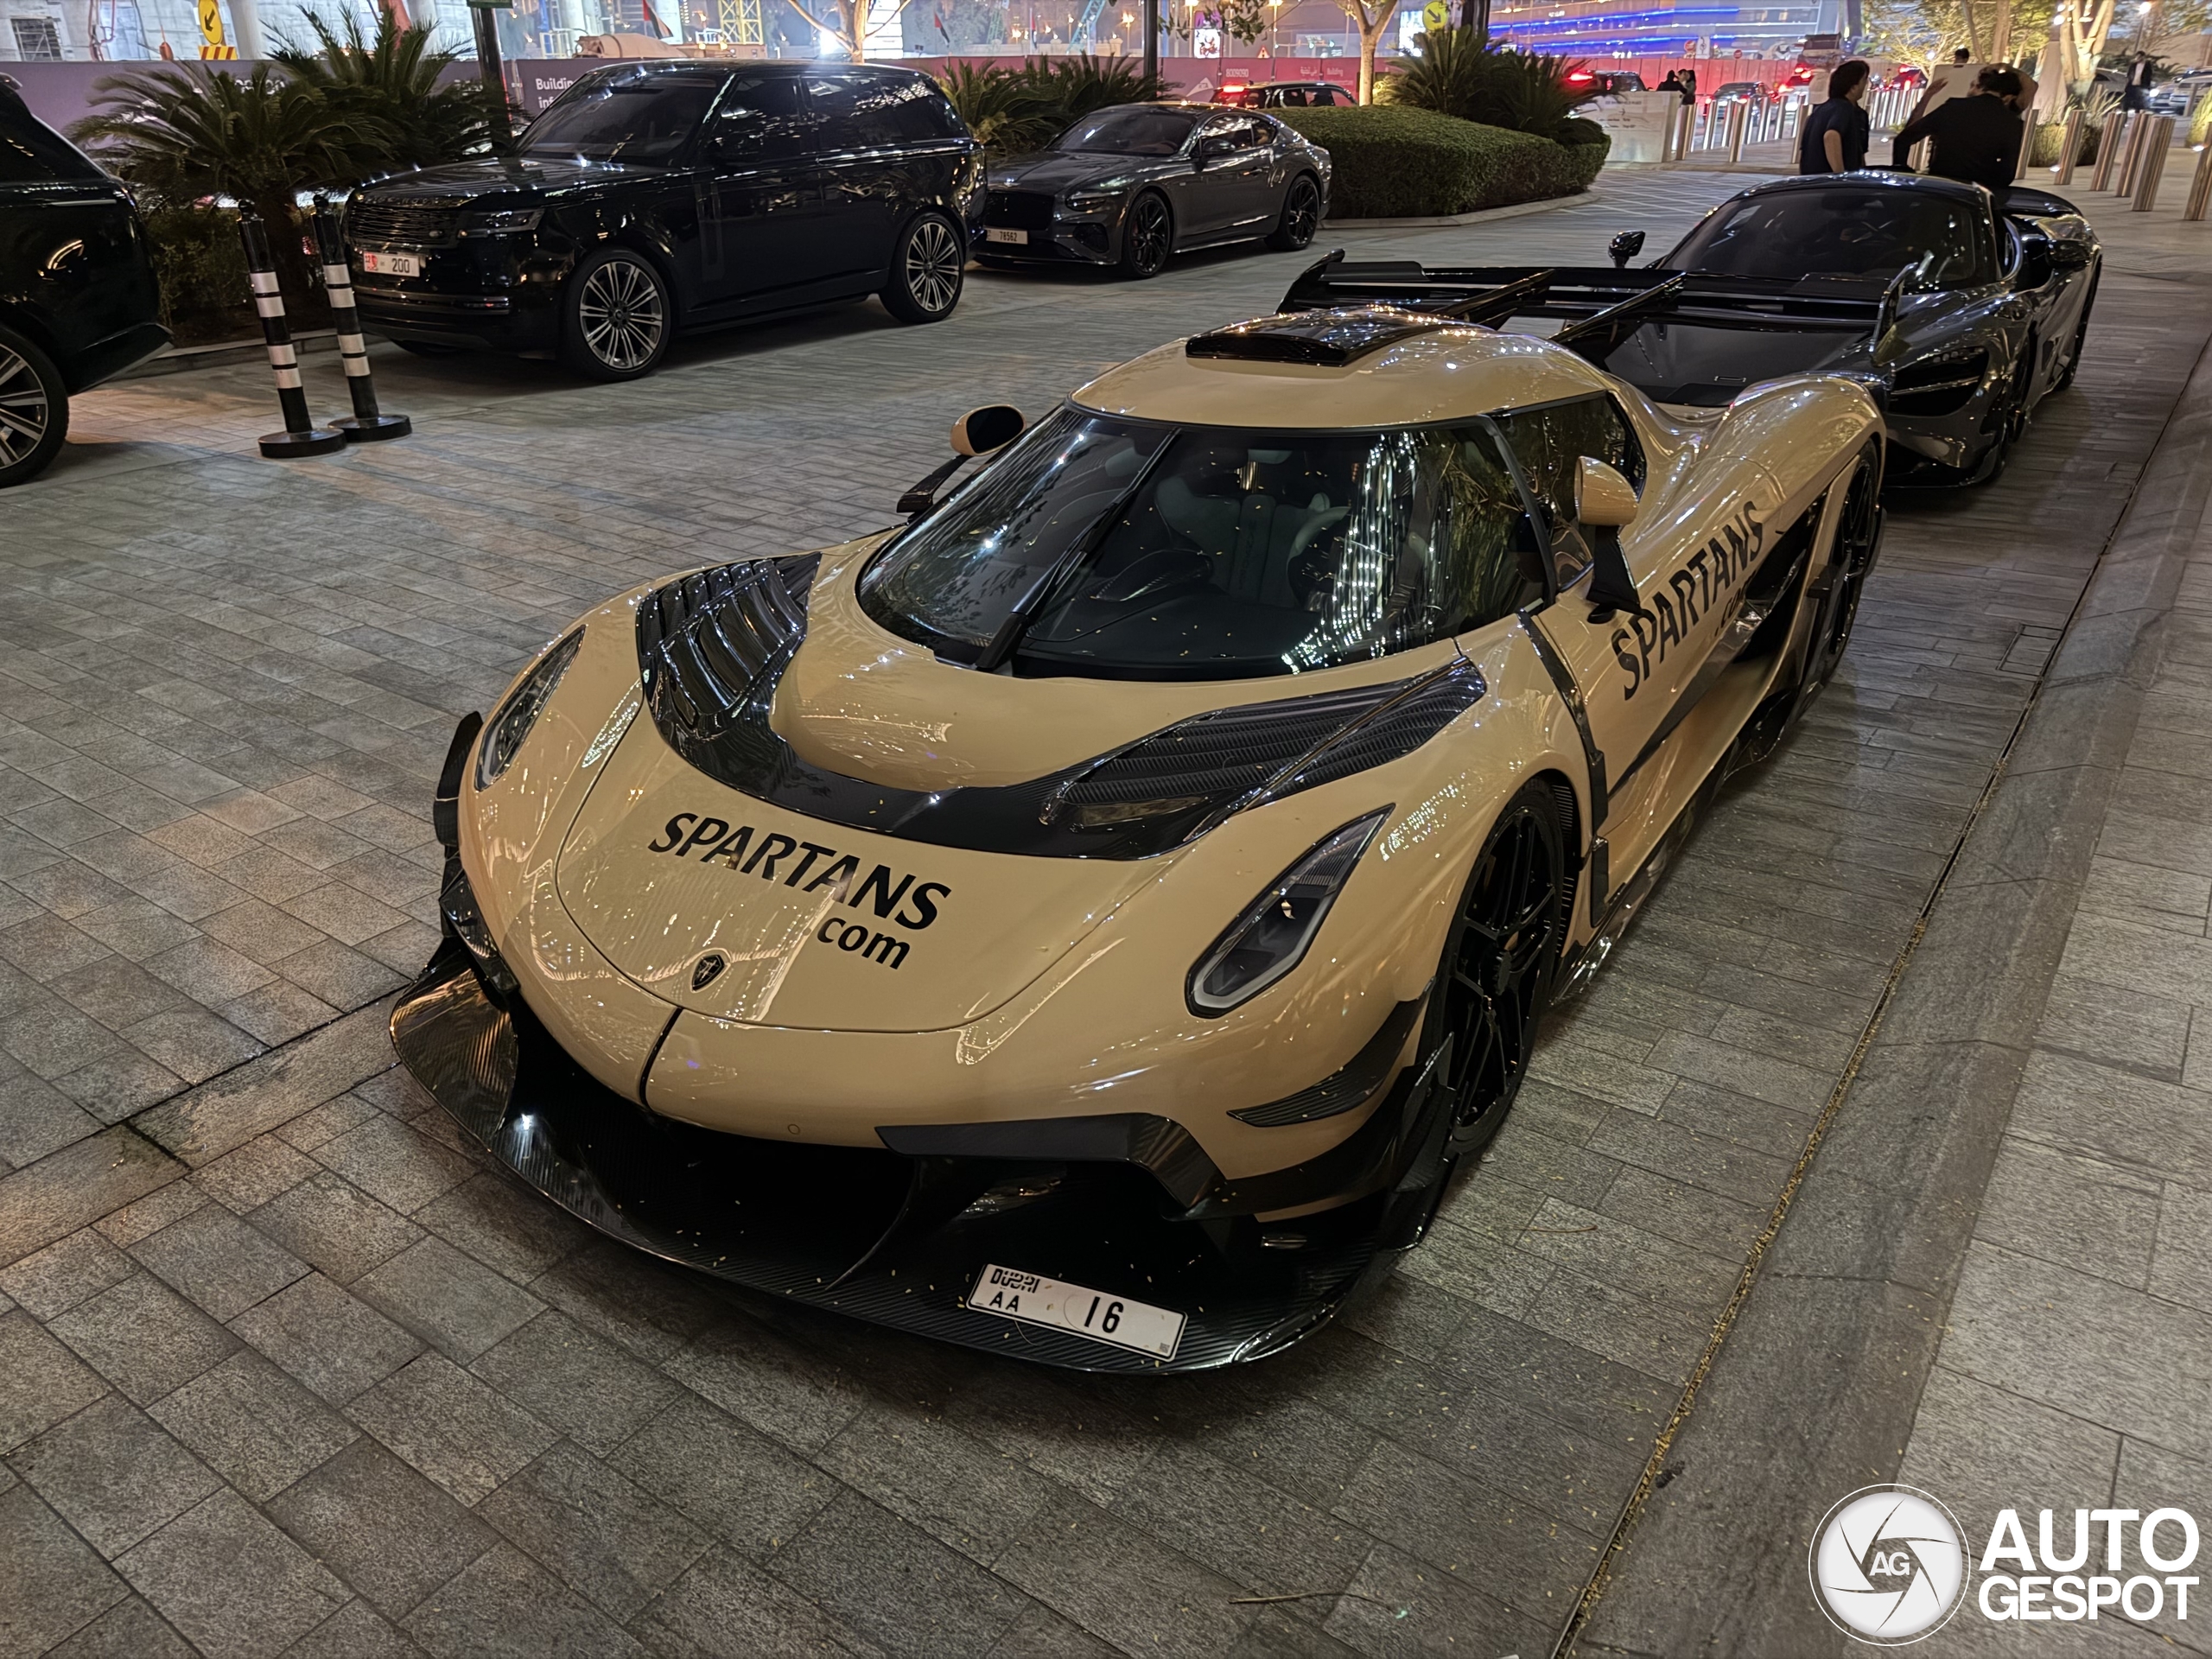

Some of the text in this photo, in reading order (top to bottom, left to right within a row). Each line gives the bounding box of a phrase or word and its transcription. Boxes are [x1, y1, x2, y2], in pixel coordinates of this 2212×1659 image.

[536, 78, 575, 90] Buildin
[391, 257, 410, 273] 200
[1611, 500, 1764, 701] SPARTANS
[647, 812, 952, 931] SPARTANS
[1084, 1296, 1124, 1333] 16
